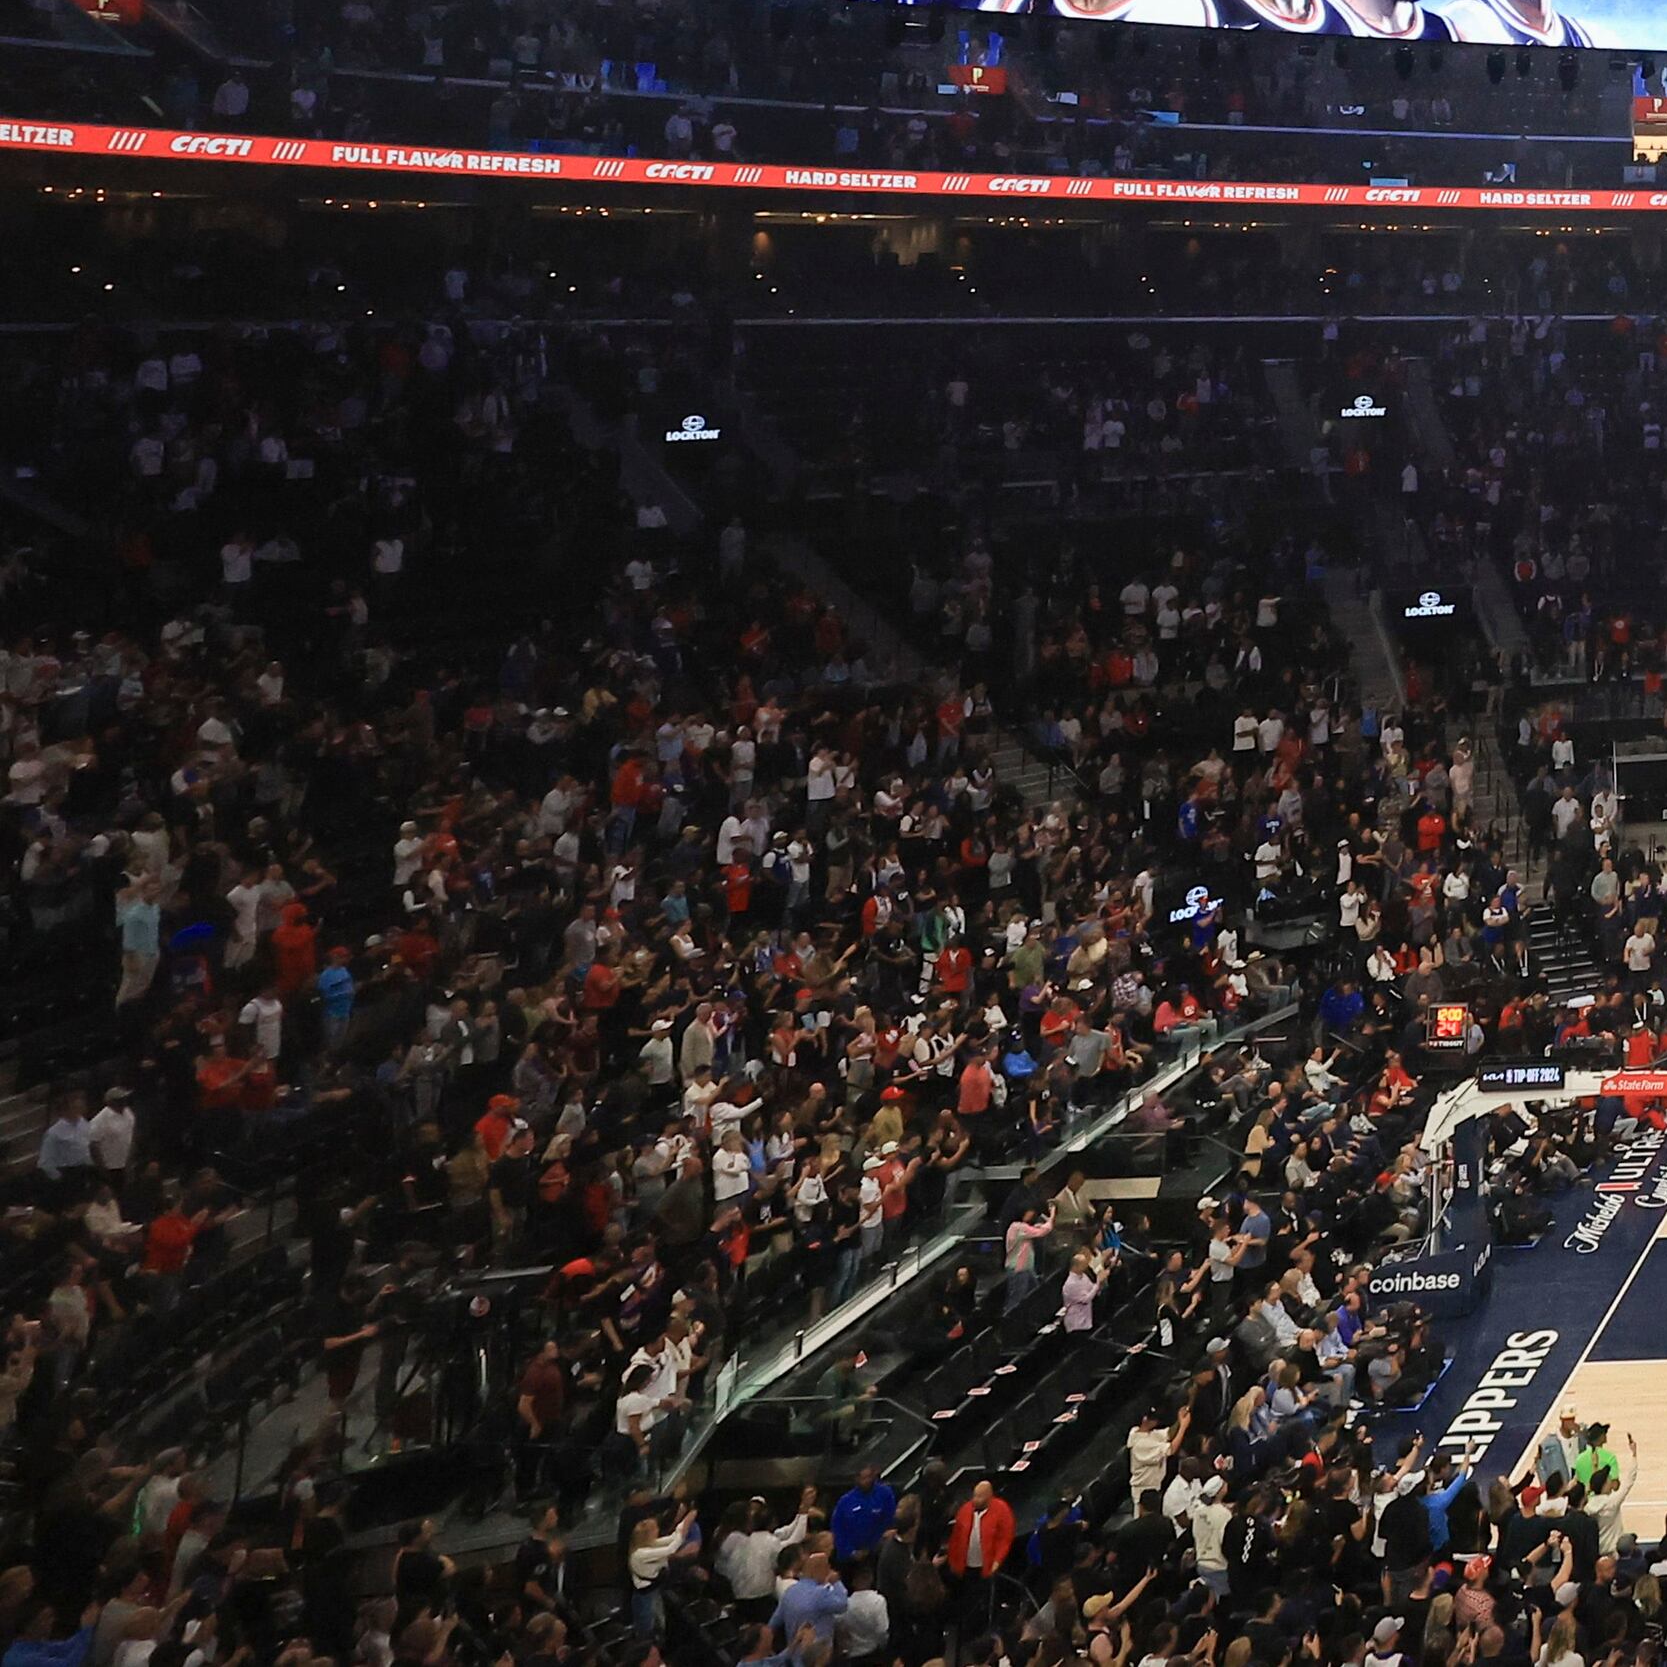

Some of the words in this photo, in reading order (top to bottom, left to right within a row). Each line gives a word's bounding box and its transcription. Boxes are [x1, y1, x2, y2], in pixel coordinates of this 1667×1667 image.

[333, 146, 382, 165] FULL
[467, 155, 561, 175] REFRESH
[785, 170, 838, 186] HARD
[840, 172, 917, 189] SELTZER
[1113, 183, 1155, 196] FULL
[1224, 186, 1299, 200] REFRESH
[1480, 193, 1525, 205] HARD
[1528, 193, 1591, 205] SELTZER
[666, 429, 720, 441] LOCKTON
[1405, 604, 1455, 617] LOCKTON
[1437, 1022, 1456, 1036] 24
[1540, 1067, 1560, 1082] 2024
[1564, 1190, 1625, 1254] Michelob
[1369, 1271, 1460, 1294] coinbase
